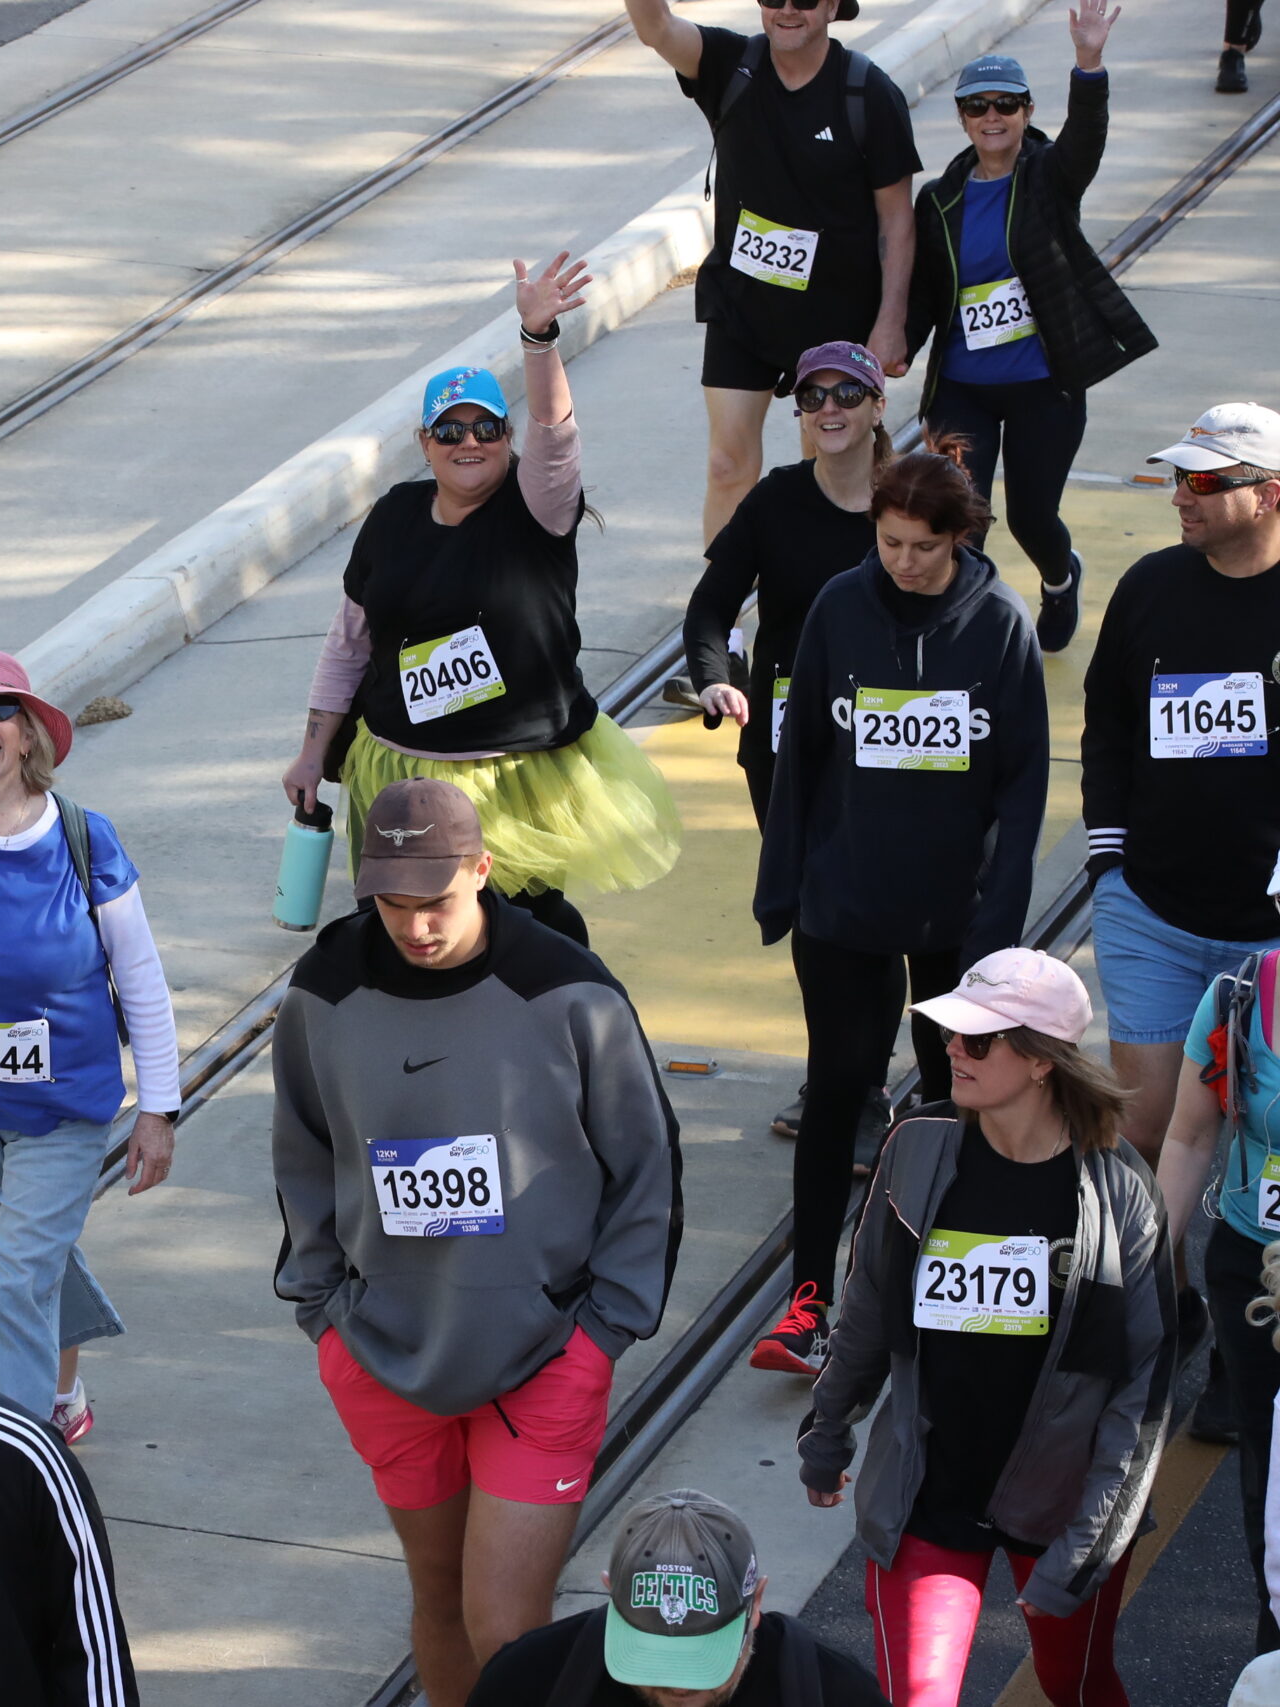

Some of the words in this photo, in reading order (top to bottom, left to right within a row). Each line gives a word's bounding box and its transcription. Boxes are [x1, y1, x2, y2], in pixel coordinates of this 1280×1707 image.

[738, 230, 808, 273] 23232
[406, 650, 491, 702] 20406
[863, 696, 883, 704] 12KM
[1160, 699, 1256, 734] 11645
[863, 713, 961, 748] 23023
[376, 1150, 398, 1158] 12KM
[476, 1145, 489, 1155] 50
[383, 1166, 491, 1209] 13398
[928, 1239, 949, 1248] 12KM
[1027, 1246, 1041, 1256] 50
[925, 1260, 1036, 1307] 23179
[656, 1564, 693, 1573] BOSTON
[631, 1571, 719, 1615] CELTICS
